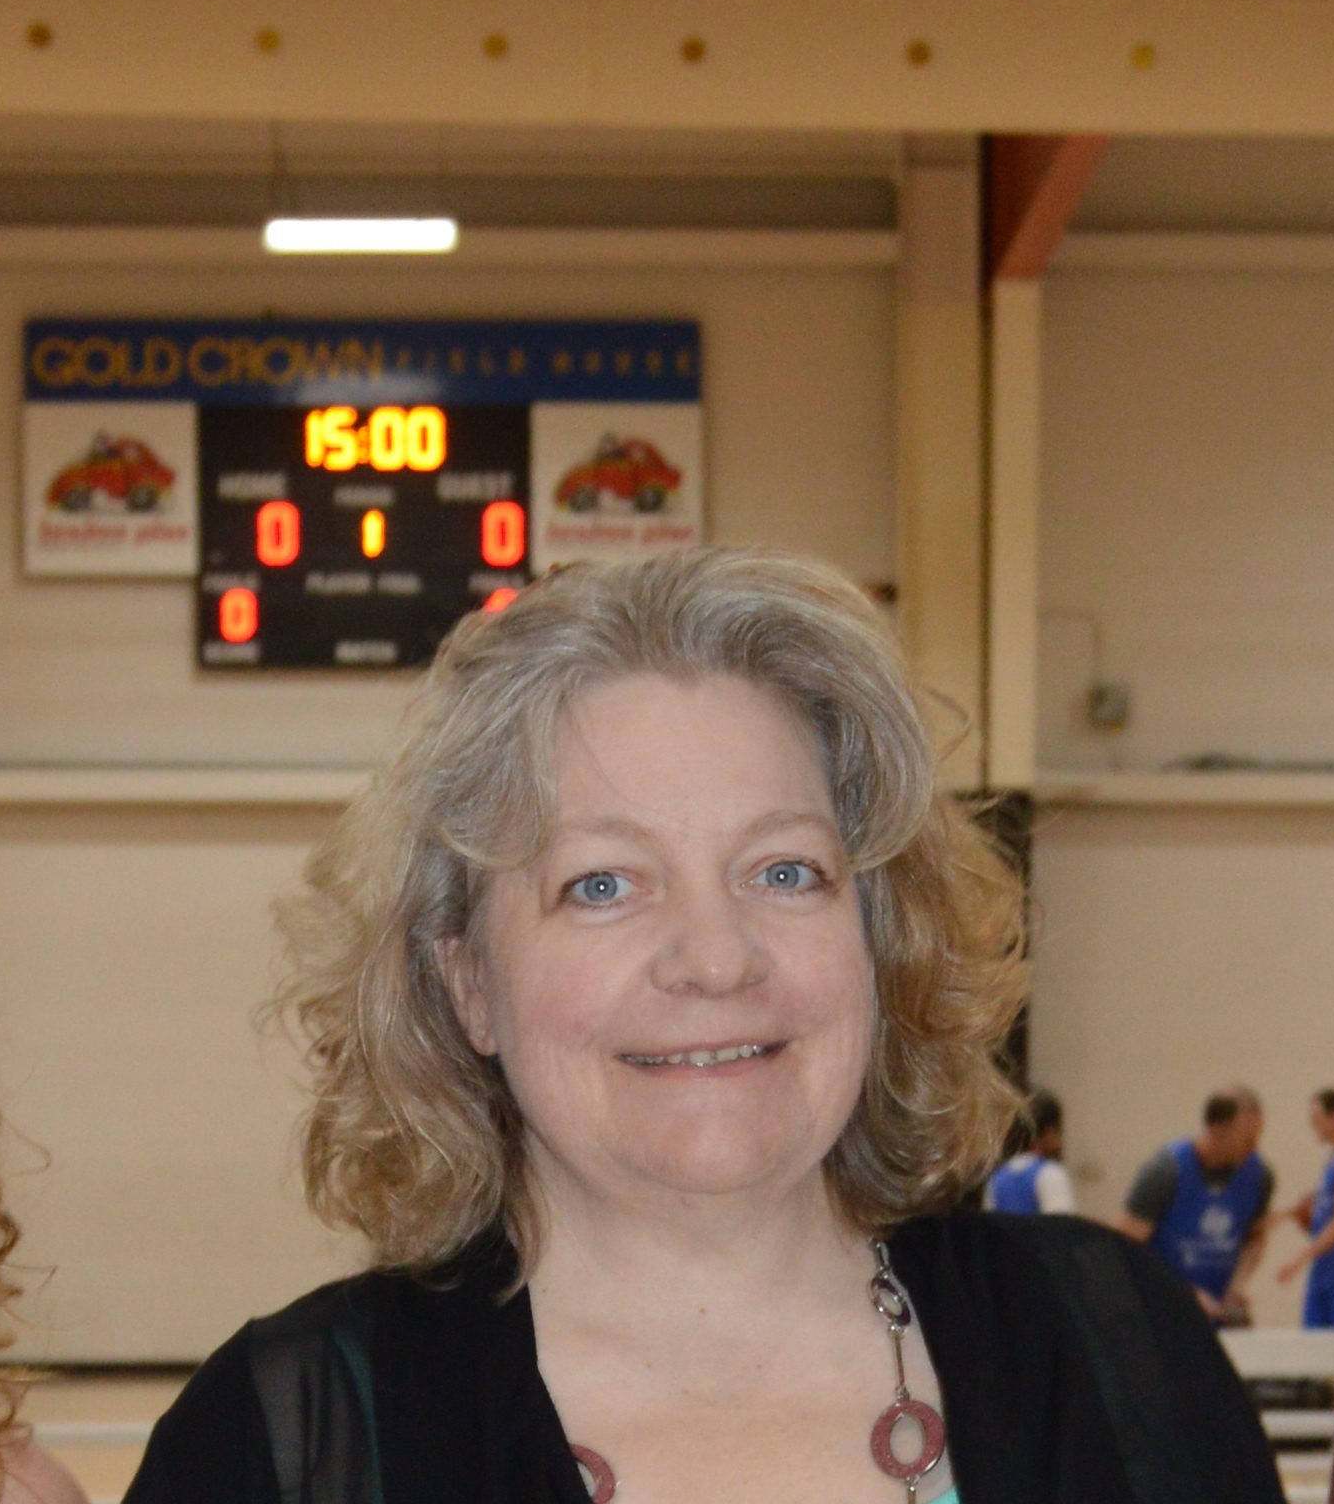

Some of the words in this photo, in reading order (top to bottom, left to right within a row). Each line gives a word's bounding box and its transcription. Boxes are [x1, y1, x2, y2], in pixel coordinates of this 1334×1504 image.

[32, 336, 183, 387] GOLD
[187, 336, 384, 387] CROWN
[305, 406, 446, 471] 15:00
[257, 501, 301, 566] 0
[362, 509, 385, 558] 1
[481, 501, 524, 566] 0
[219, 587, 258, 643] 0
